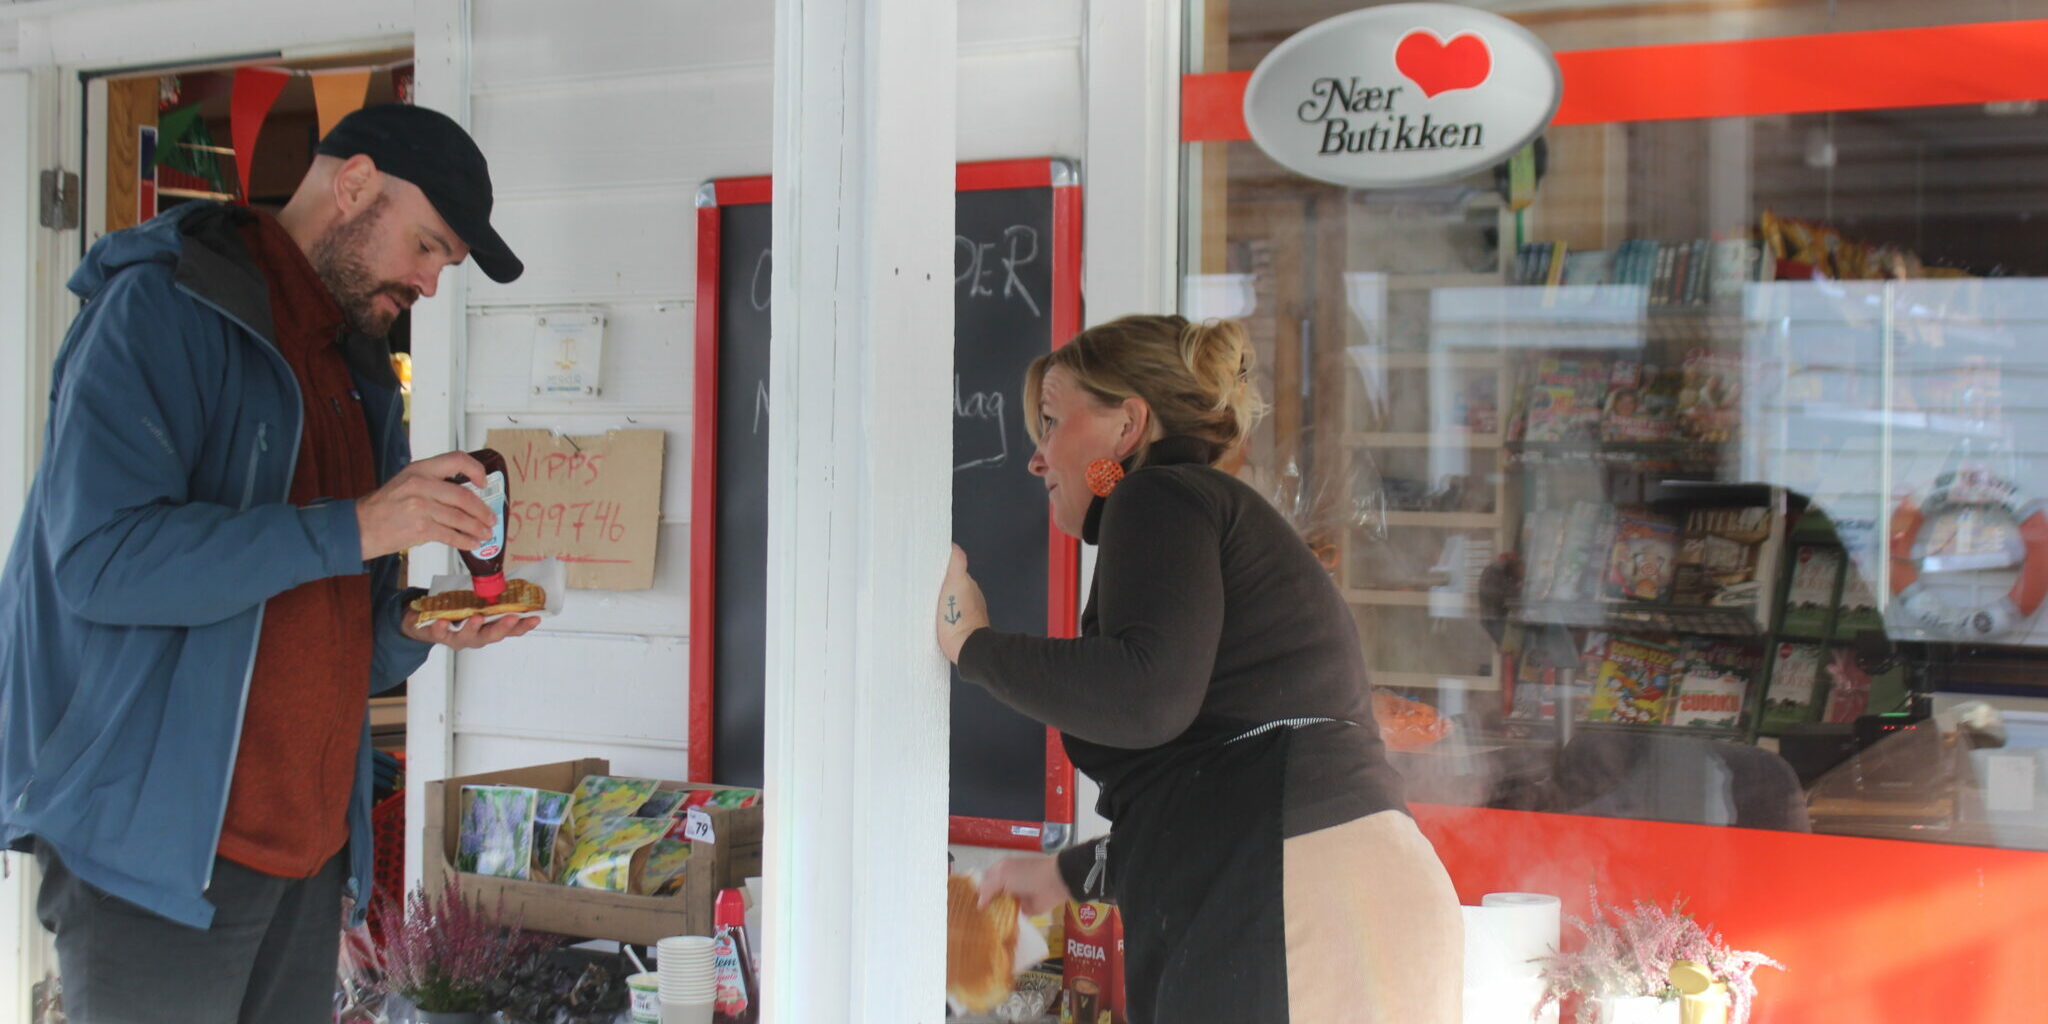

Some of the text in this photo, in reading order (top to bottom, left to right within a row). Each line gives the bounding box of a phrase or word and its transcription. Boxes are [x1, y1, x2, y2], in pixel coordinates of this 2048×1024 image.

[1297, 76, 1403, 123] Nær
[1318, 114, 1484, 155] Butikken
[512, 441, 607, 486] VIPPS
[507, 501, 625, 542] 599746
[1679, 693, 1741, 712] SUDOKU
[696, 821, 708, 837] 79
[1067, 938, 1106, 962] REGIA
